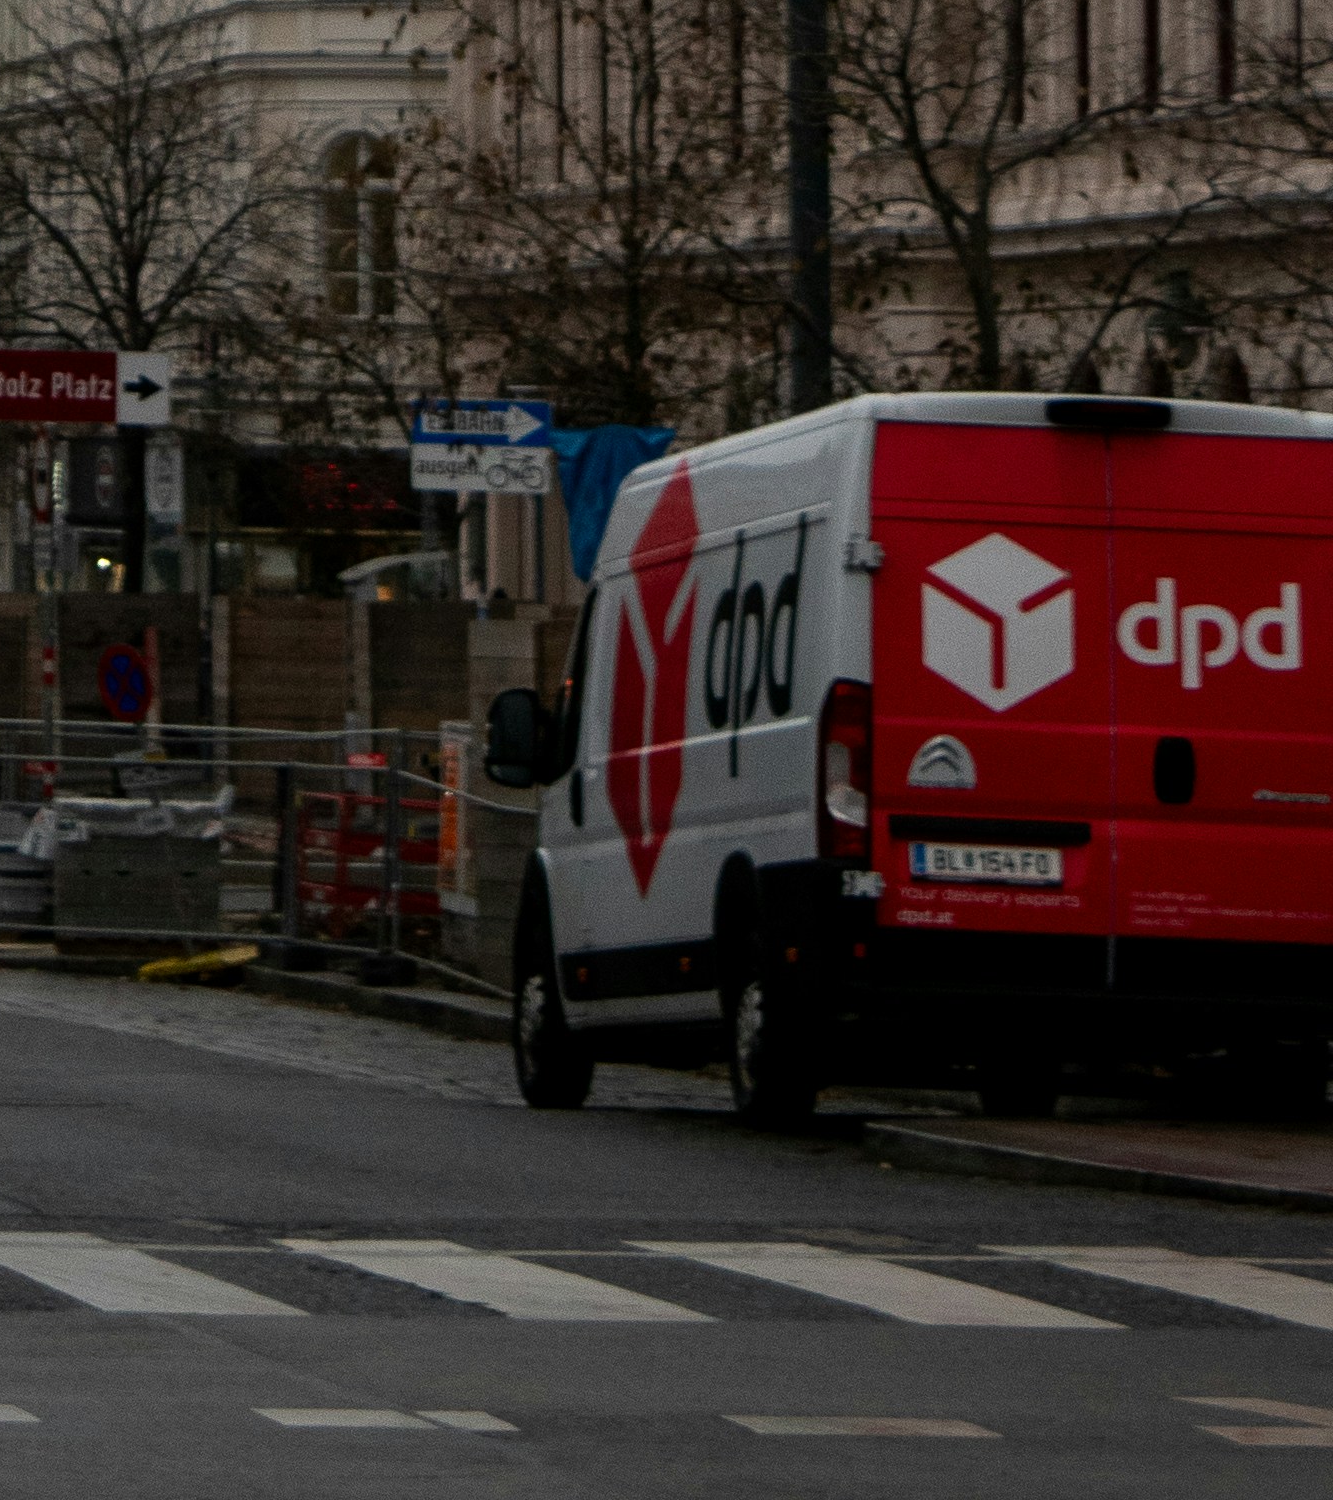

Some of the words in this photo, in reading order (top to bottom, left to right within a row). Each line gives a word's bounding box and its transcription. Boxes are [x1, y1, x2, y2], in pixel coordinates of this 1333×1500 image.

[50, 371, 114, 400] Platz
[704, 510, 807, 779] dpd
[1116, 576, 1303, 691] dpd
